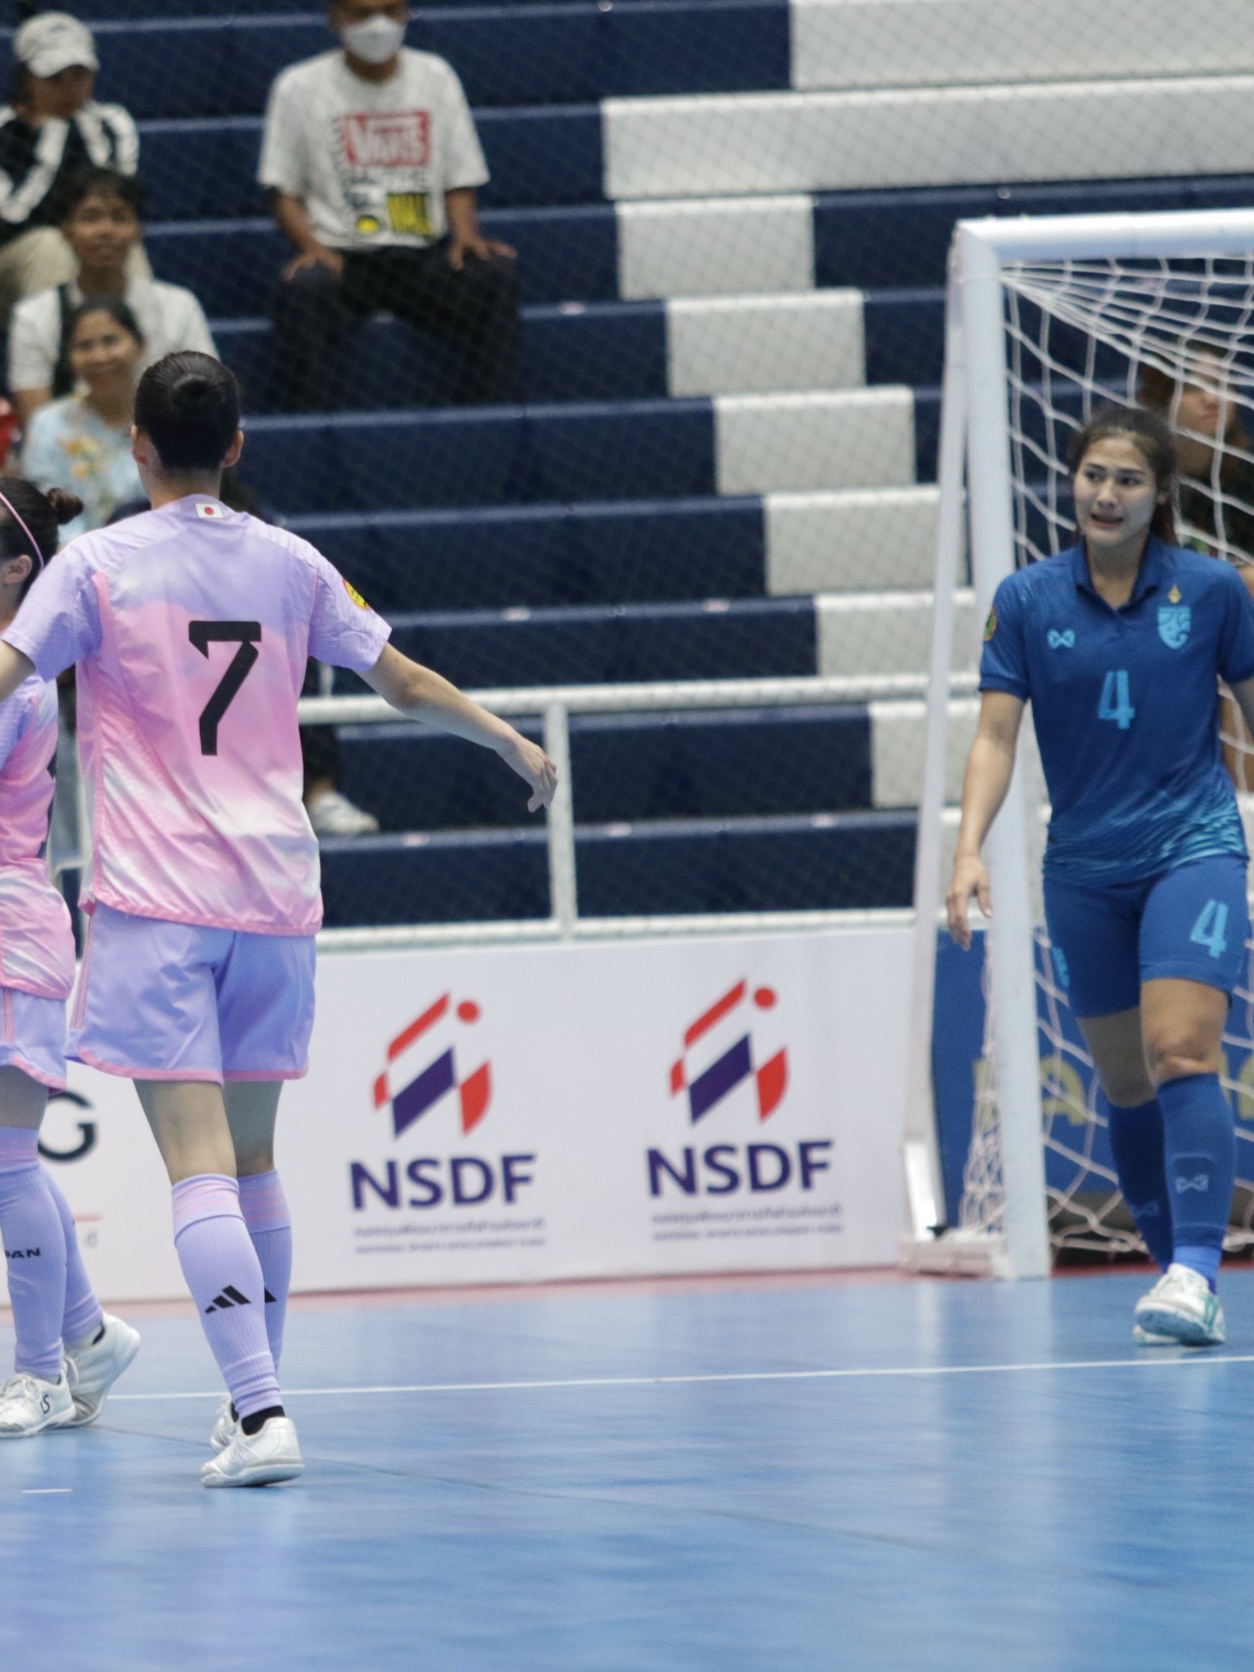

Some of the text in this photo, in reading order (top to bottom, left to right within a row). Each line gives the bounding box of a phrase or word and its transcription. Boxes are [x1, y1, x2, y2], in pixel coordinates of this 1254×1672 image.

[188, 620, 262, 756] 7
[1098, 670, 1135, 730] 4
[1190, 899, 1229, 958] 4
[350, 1154, 535, 1210] NSDF
[647, 1140, 831, 1196] NSDF
